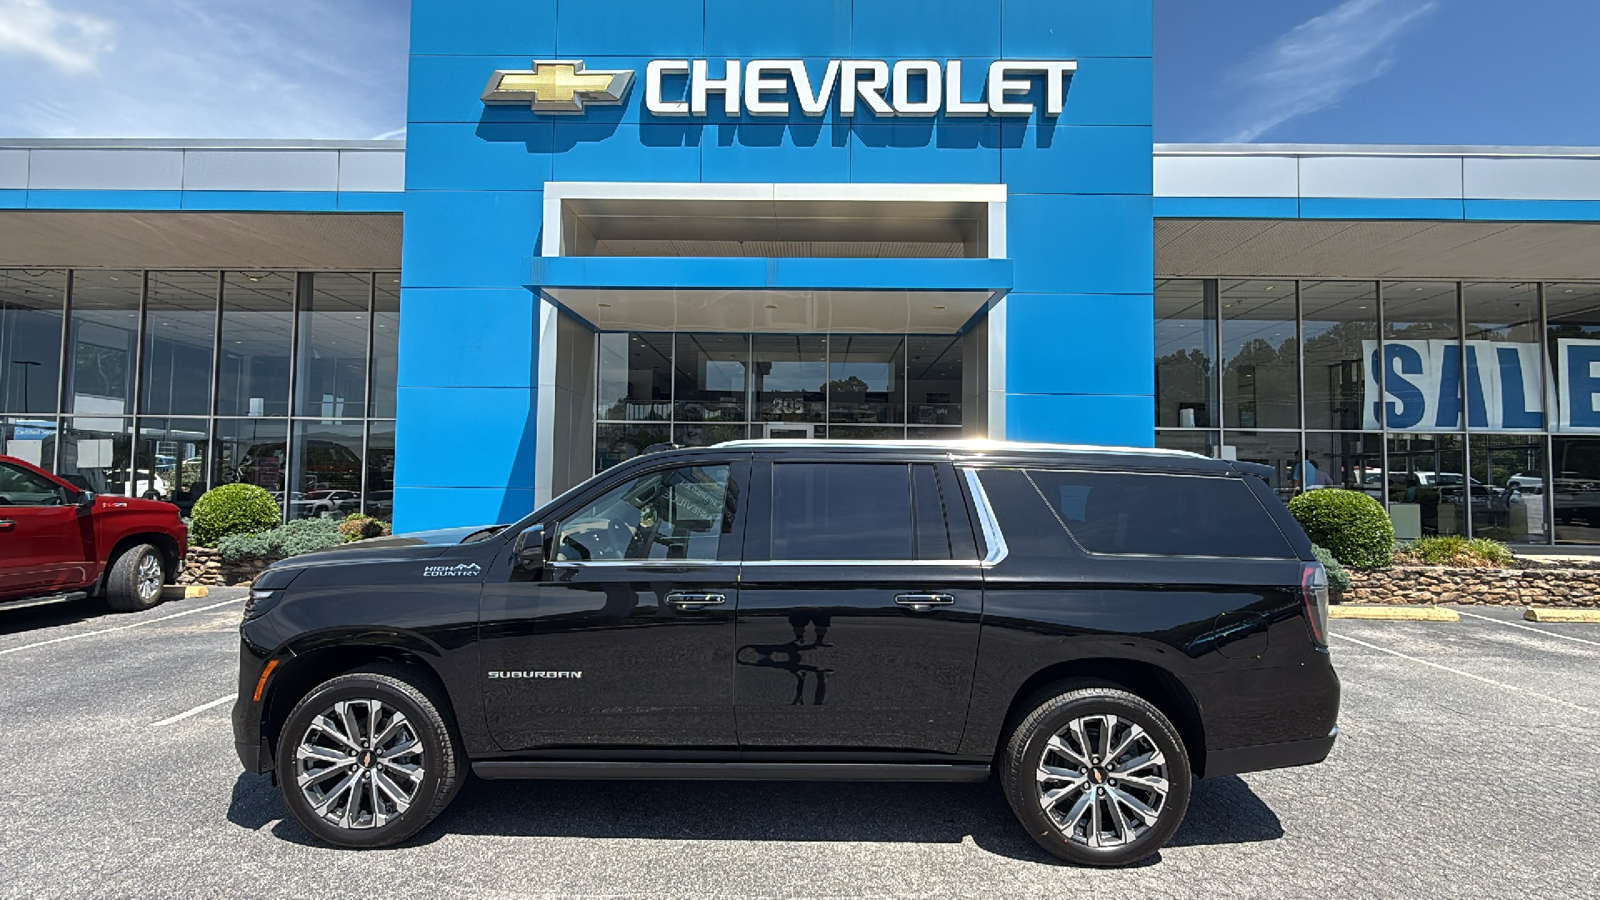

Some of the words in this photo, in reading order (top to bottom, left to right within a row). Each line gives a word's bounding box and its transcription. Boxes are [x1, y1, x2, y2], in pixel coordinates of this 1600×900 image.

[646, 59, 1077, 117] CHEVROLET
[1371, 343, 1600, 428] SALE
[773, 398, 804, 414] 205
[487, 671, 583, 679] SUBURBAN
